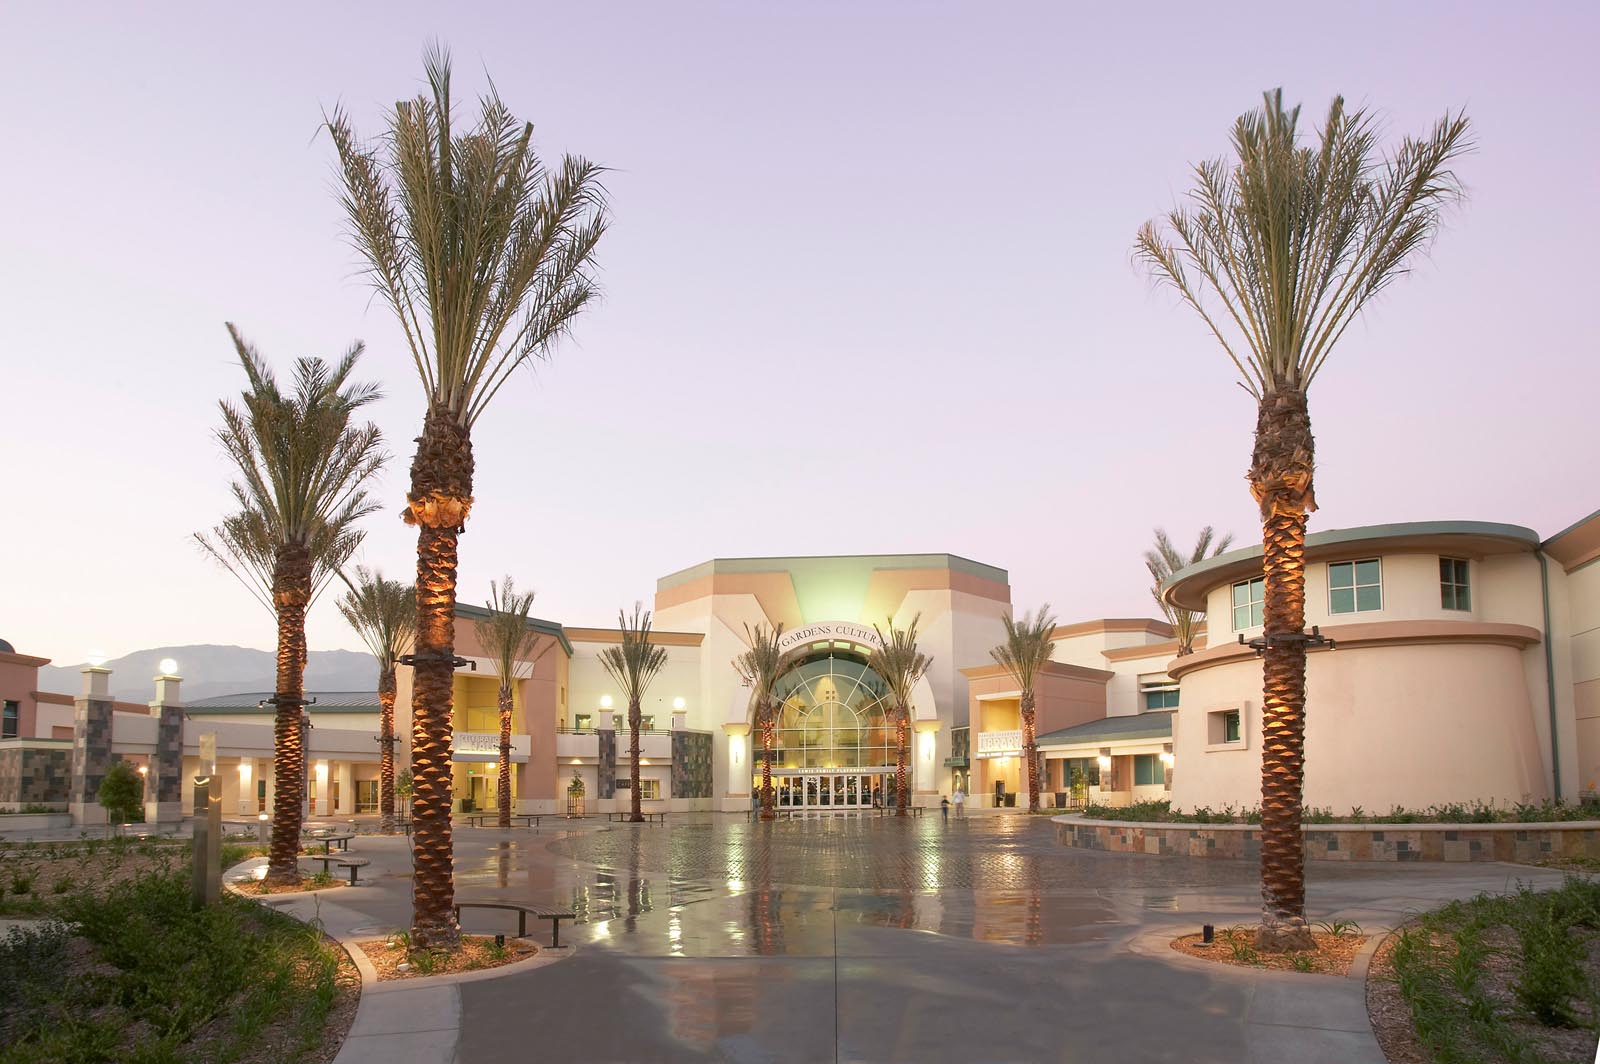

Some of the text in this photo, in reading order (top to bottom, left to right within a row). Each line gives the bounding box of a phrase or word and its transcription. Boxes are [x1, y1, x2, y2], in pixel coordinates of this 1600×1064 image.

[782, 626, 887, 647] GARDENS CULTURA
[460, 735, 500, 744] CELEBRATIO
[979, 736, 1021, 750] LIBRARY
